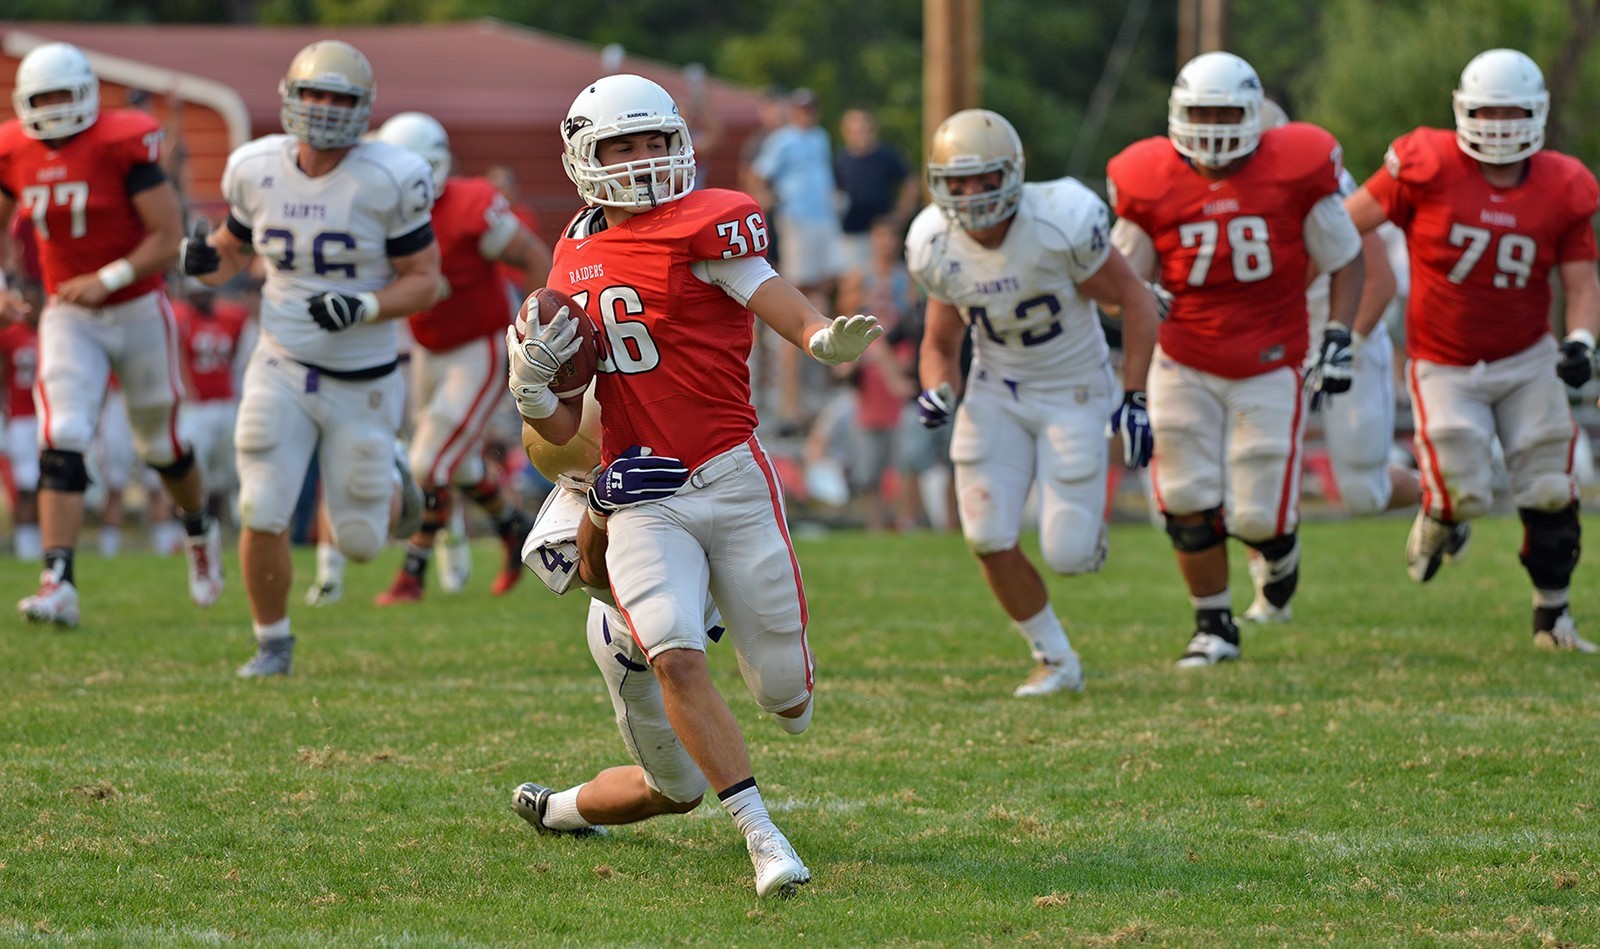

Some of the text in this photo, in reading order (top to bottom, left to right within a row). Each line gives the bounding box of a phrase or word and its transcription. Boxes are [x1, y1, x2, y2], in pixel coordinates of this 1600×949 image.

[21, 180, 90, 241] 77
[715, 211, 769, 260] 36
[568, 263, 605, 285] RAIDERS
[1178, 214, 1273, 287] 78
[1447, 222, 1537, 288] 79
